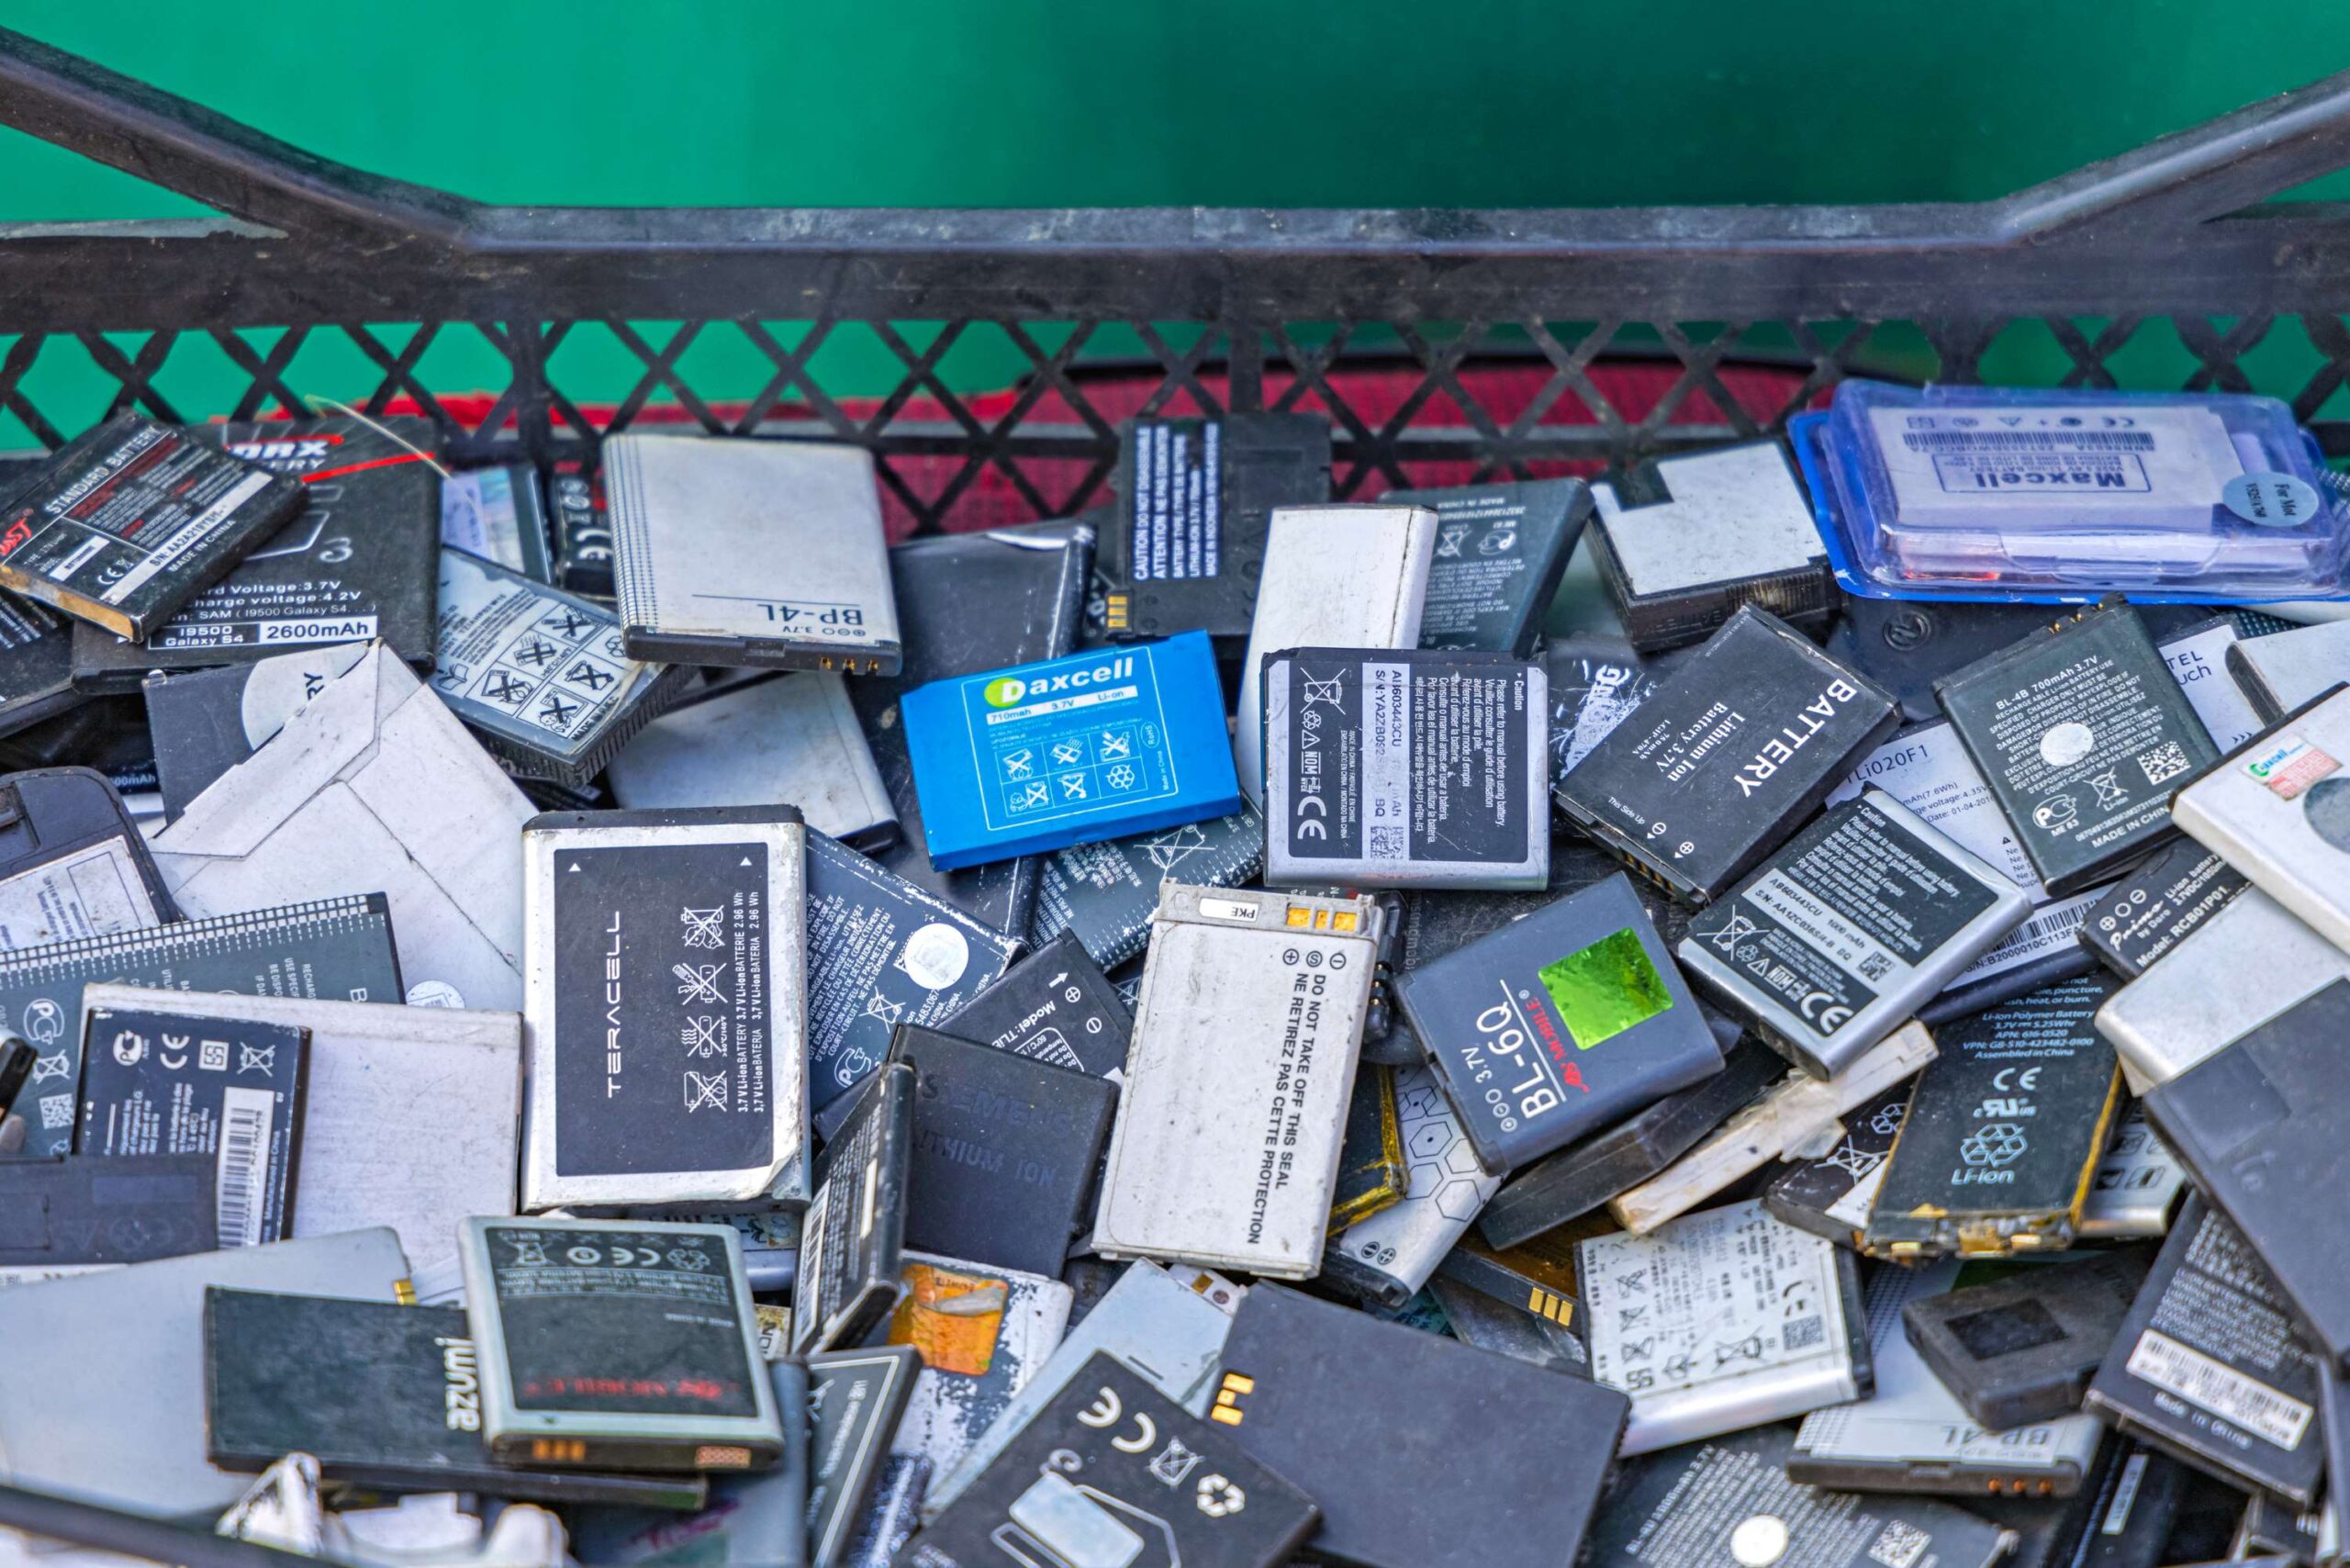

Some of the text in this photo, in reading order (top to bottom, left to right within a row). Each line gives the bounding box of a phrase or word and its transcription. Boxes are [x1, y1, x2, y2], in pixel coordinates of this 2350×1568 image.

[46, 426, 160, 512] STANDARD BATTERY
[1973, 472, 2126, 487] Maxcell
[1135, 492, 1148, 579] CAUTION DO NOT
[1153, 477, 1167, 578] ATTENTION NE PAS
[168, 521, 235, 571] MADE IN CHINA
[230, 580, 341, 595] Voltage:3.7V
[250, 591, 362, 607] voltage:4.2V
[198, 610, 231, 620] SAM
[284, 605, 326, 618] Galaxy
[757, 604, 863, 625] BP-4L
[165, 634, 244, 647] Galaxy S4
[266, 622, 368, 639] 2600mAh
[783, 625, 813, 633] 3.7V
[999, 658, 1132, 701] Daxcell
[1427, 677, 1438, 689] Por
[1495, 679, 1505, 701] Please
[1996, 655, 2097, 709] BL-4B 700mAh 3.7V
[1996, 660, 2113, 720] RECHARGE ABLE USE
[990, 689, 1123, 722] 710mah 3.7V Li-on
[1514, 680, 1523, 710] Caution
[1483, 678, 1494, 767] Veuillez consulter guide
[1495, 703, 1505, 719] refer
[1681, 702, 1728, 743] Battery
[1990, 696, 2059, 733] SPECIFIED CHARGER
[1145, 724, 1154, 745] RoHS
[1495, 729, 1505, 755] manual
[1667, 712, 1744, 781] Lithium Ion
[1736, 680, 1852, 795] BATTERY
[1303, 751, 1317, 773] NOM
[1495, 756, 1505, 778] before
[1656, 744, 1684, 772] 3.7V
[1494, 779, 1505, 799] using
[2103, 797, 2128, 811] Li-ion
[1297, 795, 1326, 840] CE
[1374, 798, 1384, 817] BQ
[1608, 797, 1645, 824] This Side Up
[1861, 807, 1886, 827] Caution
[1927, 812, 1946, 824] Date:
[2092, 806, 2169, 846] MADE IN CHIN
[2165, 854, 2217, 898] Li-ion battery
[833, 896, 844, 911] NOT
[1231, 907, 1257, 919] PKE
[1770, 879, 1821, 915] AB603443CU
[1845, 934, 1864, 948] mAh
[285, 958, 295, 971] USE
[829, 946, 850, 979] CHARGEUR
[2137, 936, 2172, 966] Model:
[303, 964, 316, 1001] RECHARG
[863, 976, 875, 990] PAS
[2053, 986, 2102, 995] puncture,
[607, 911, 621, 1097] TERACELL
[734, 909, 748, 1112] 3.7 Li-ion BATTERY 3.7 Li-ion BATTERIE 2.96
[816, 935, 889, 1061] D'EXPOSITION PAS METTRE
[1801, 991, 1854, 1035] CE
[749, 936, 765, 1112] 3,7 Li-ion BATERIA 3,7 Li-ion BATERIA
[1015, 1001, 1055, 1032] Model:
[1526, 997, 1566, 1059] MOBILE
[2012, 1011, 2054, 1021] Polymer
[2055, 1010, 2094, 1018] Battery
[160, 1033, 191, 1070] CE
[1461, 1047, 1492, 1082] 3.7V
[1477, 1002, 1557, 1116] BL-6Q
[1975, 1048, 2031, 1058] Assembled
[2043, 1047, 2075, 1056] China
[1274, 973, 1326, 1190] DO NOT TAKE OFF THIS SEAL
[1993, 1068, 2042, 1091] CE
[1248, 971, 1308, 1244] NE RETIREZ PAS CETTE PROTECTION
[1950, 1166, 2014, 1185] Li-ion
[440, 1335, 480, 1431] azumi
[1078, 1388, 1155, 1451] CE
[2154, 1394, 2249, 1449] Made China
[1943, 1425, 2048, 1446] BP4L
